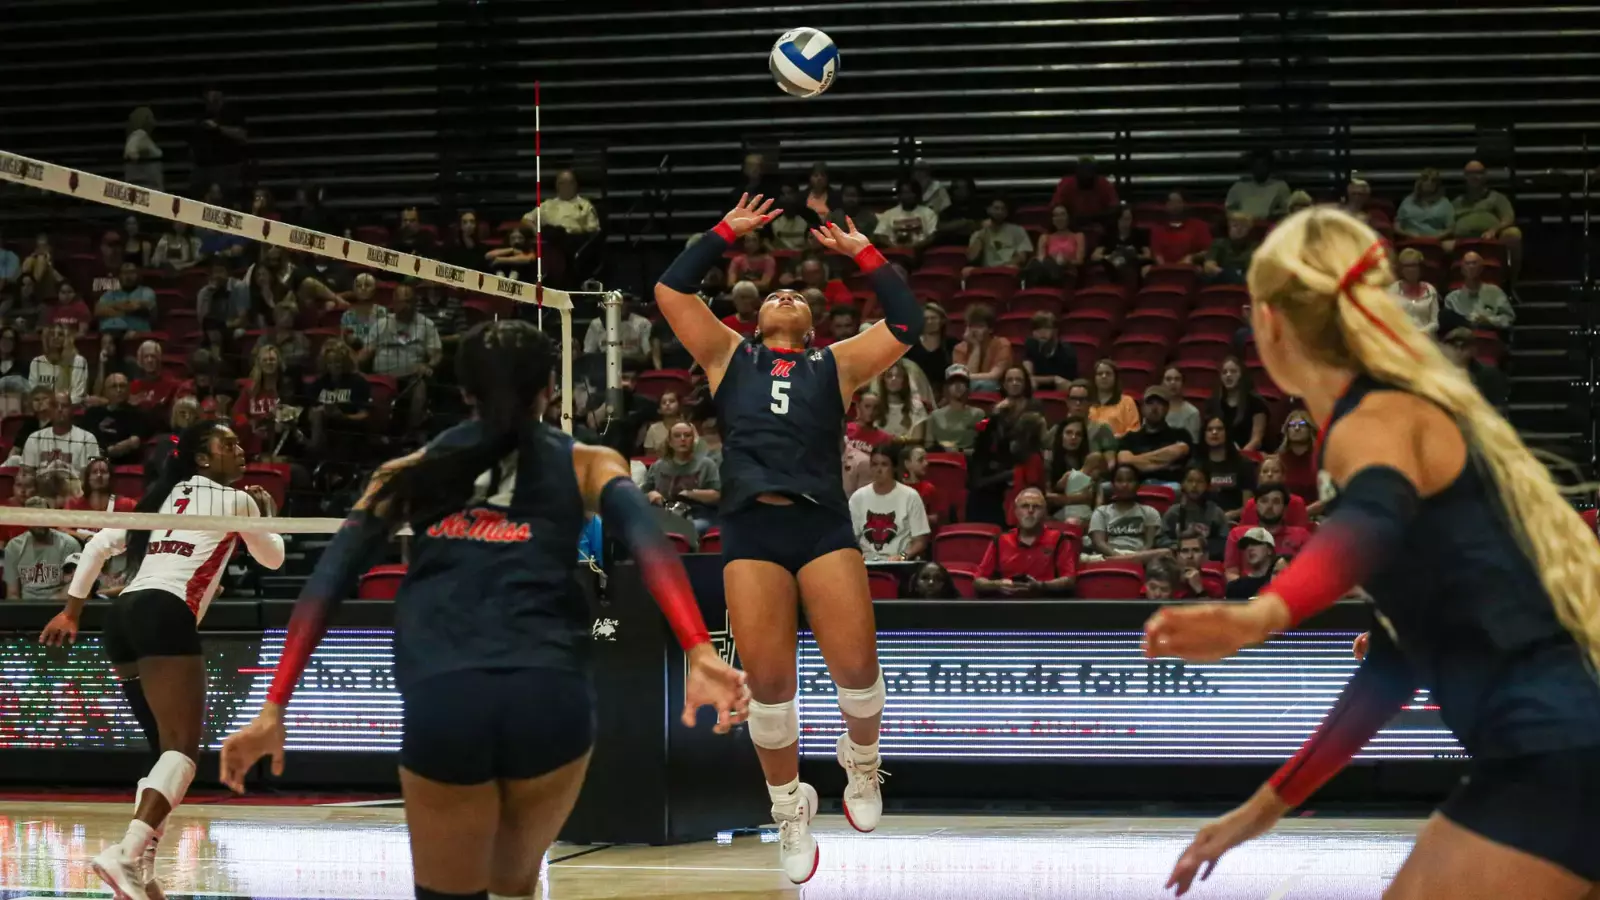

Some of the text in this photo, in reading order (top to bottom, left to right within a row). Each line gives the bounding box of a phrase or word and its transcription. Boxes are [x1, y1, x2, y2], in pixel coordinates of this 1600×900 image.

[770, 380, 791, 414] 5
[468, 507, 532, 541] Miss
[926, 662, 1064, 695] friends
[1077, 662, 1134, 695] for
[1146, 662, 1220, 696] life.
